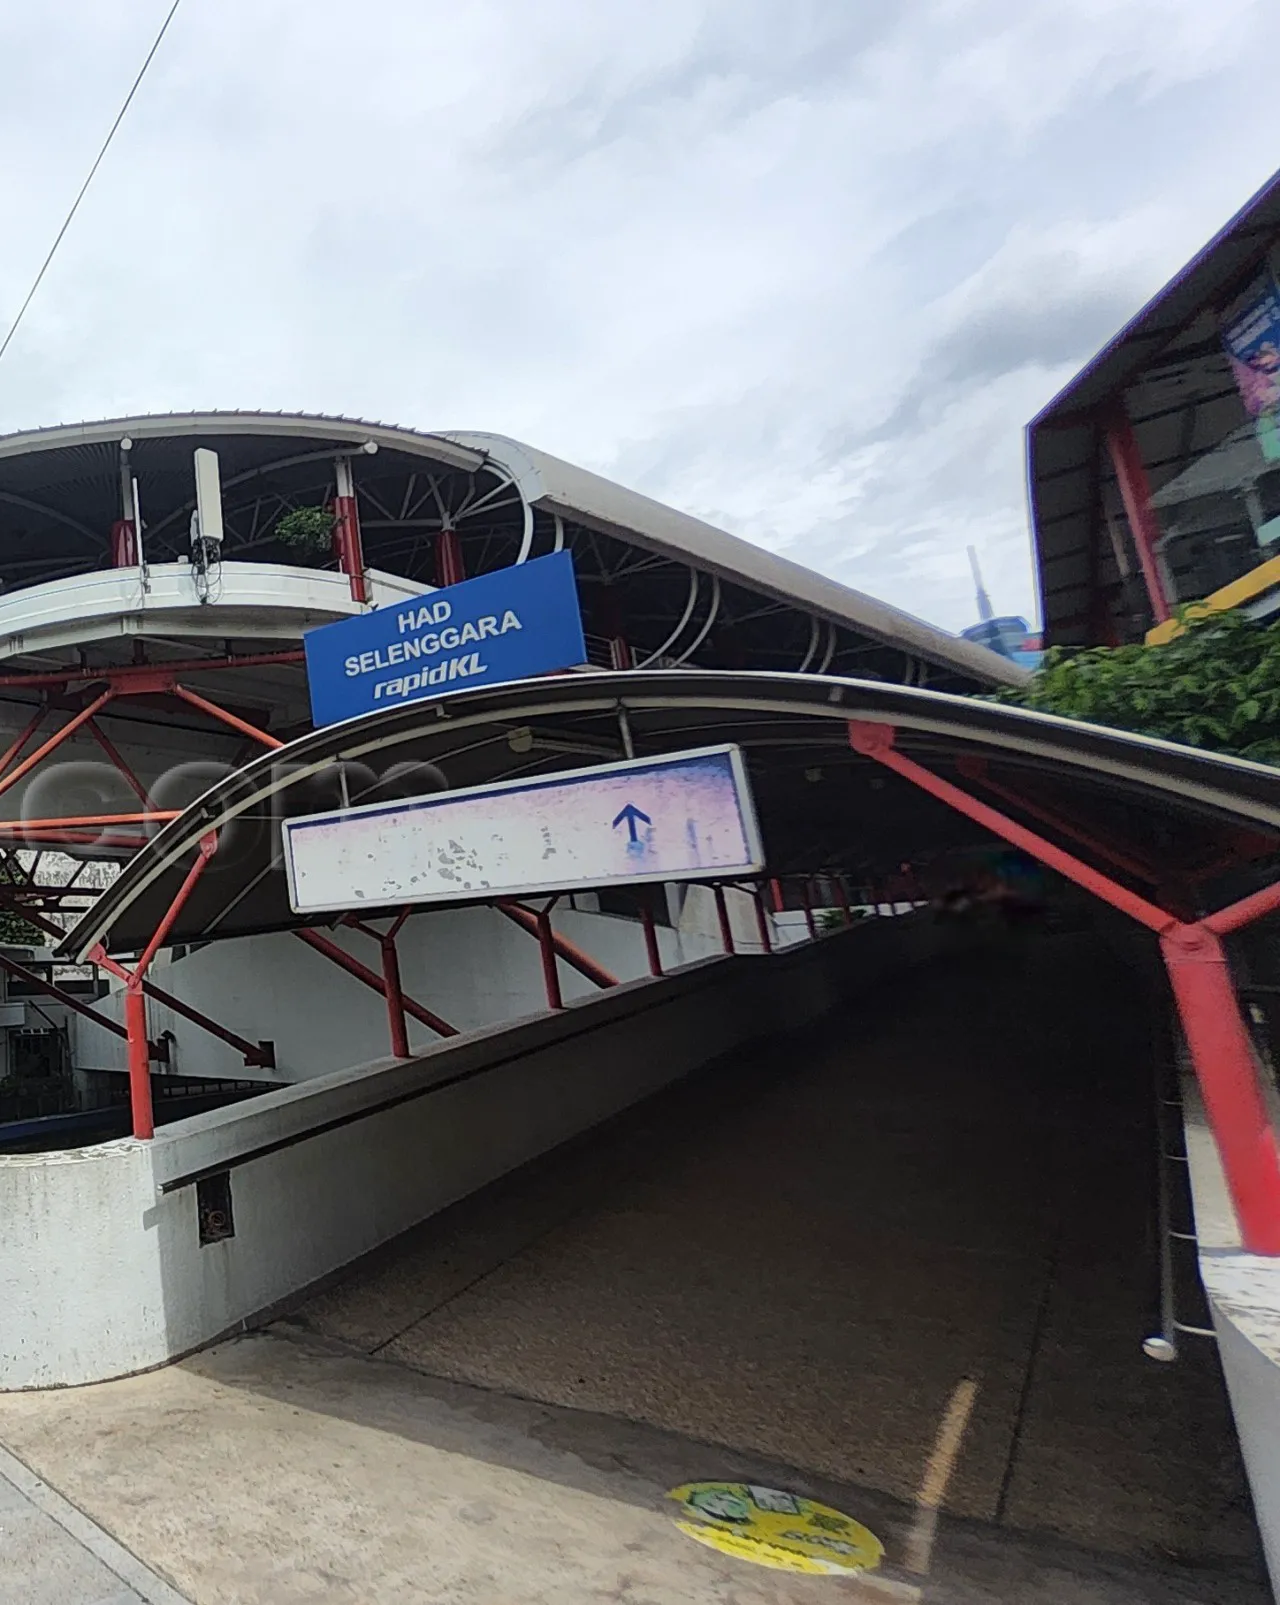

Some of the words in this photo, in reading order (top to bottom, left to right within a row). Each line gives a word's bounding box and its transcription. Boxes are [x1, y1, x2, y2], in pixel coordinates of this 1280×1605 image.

[397, 601, 452, 634] HAD
[344, 610, 522, 677] SELENGGARA
[373, 652, 488, 700] rapidKL
